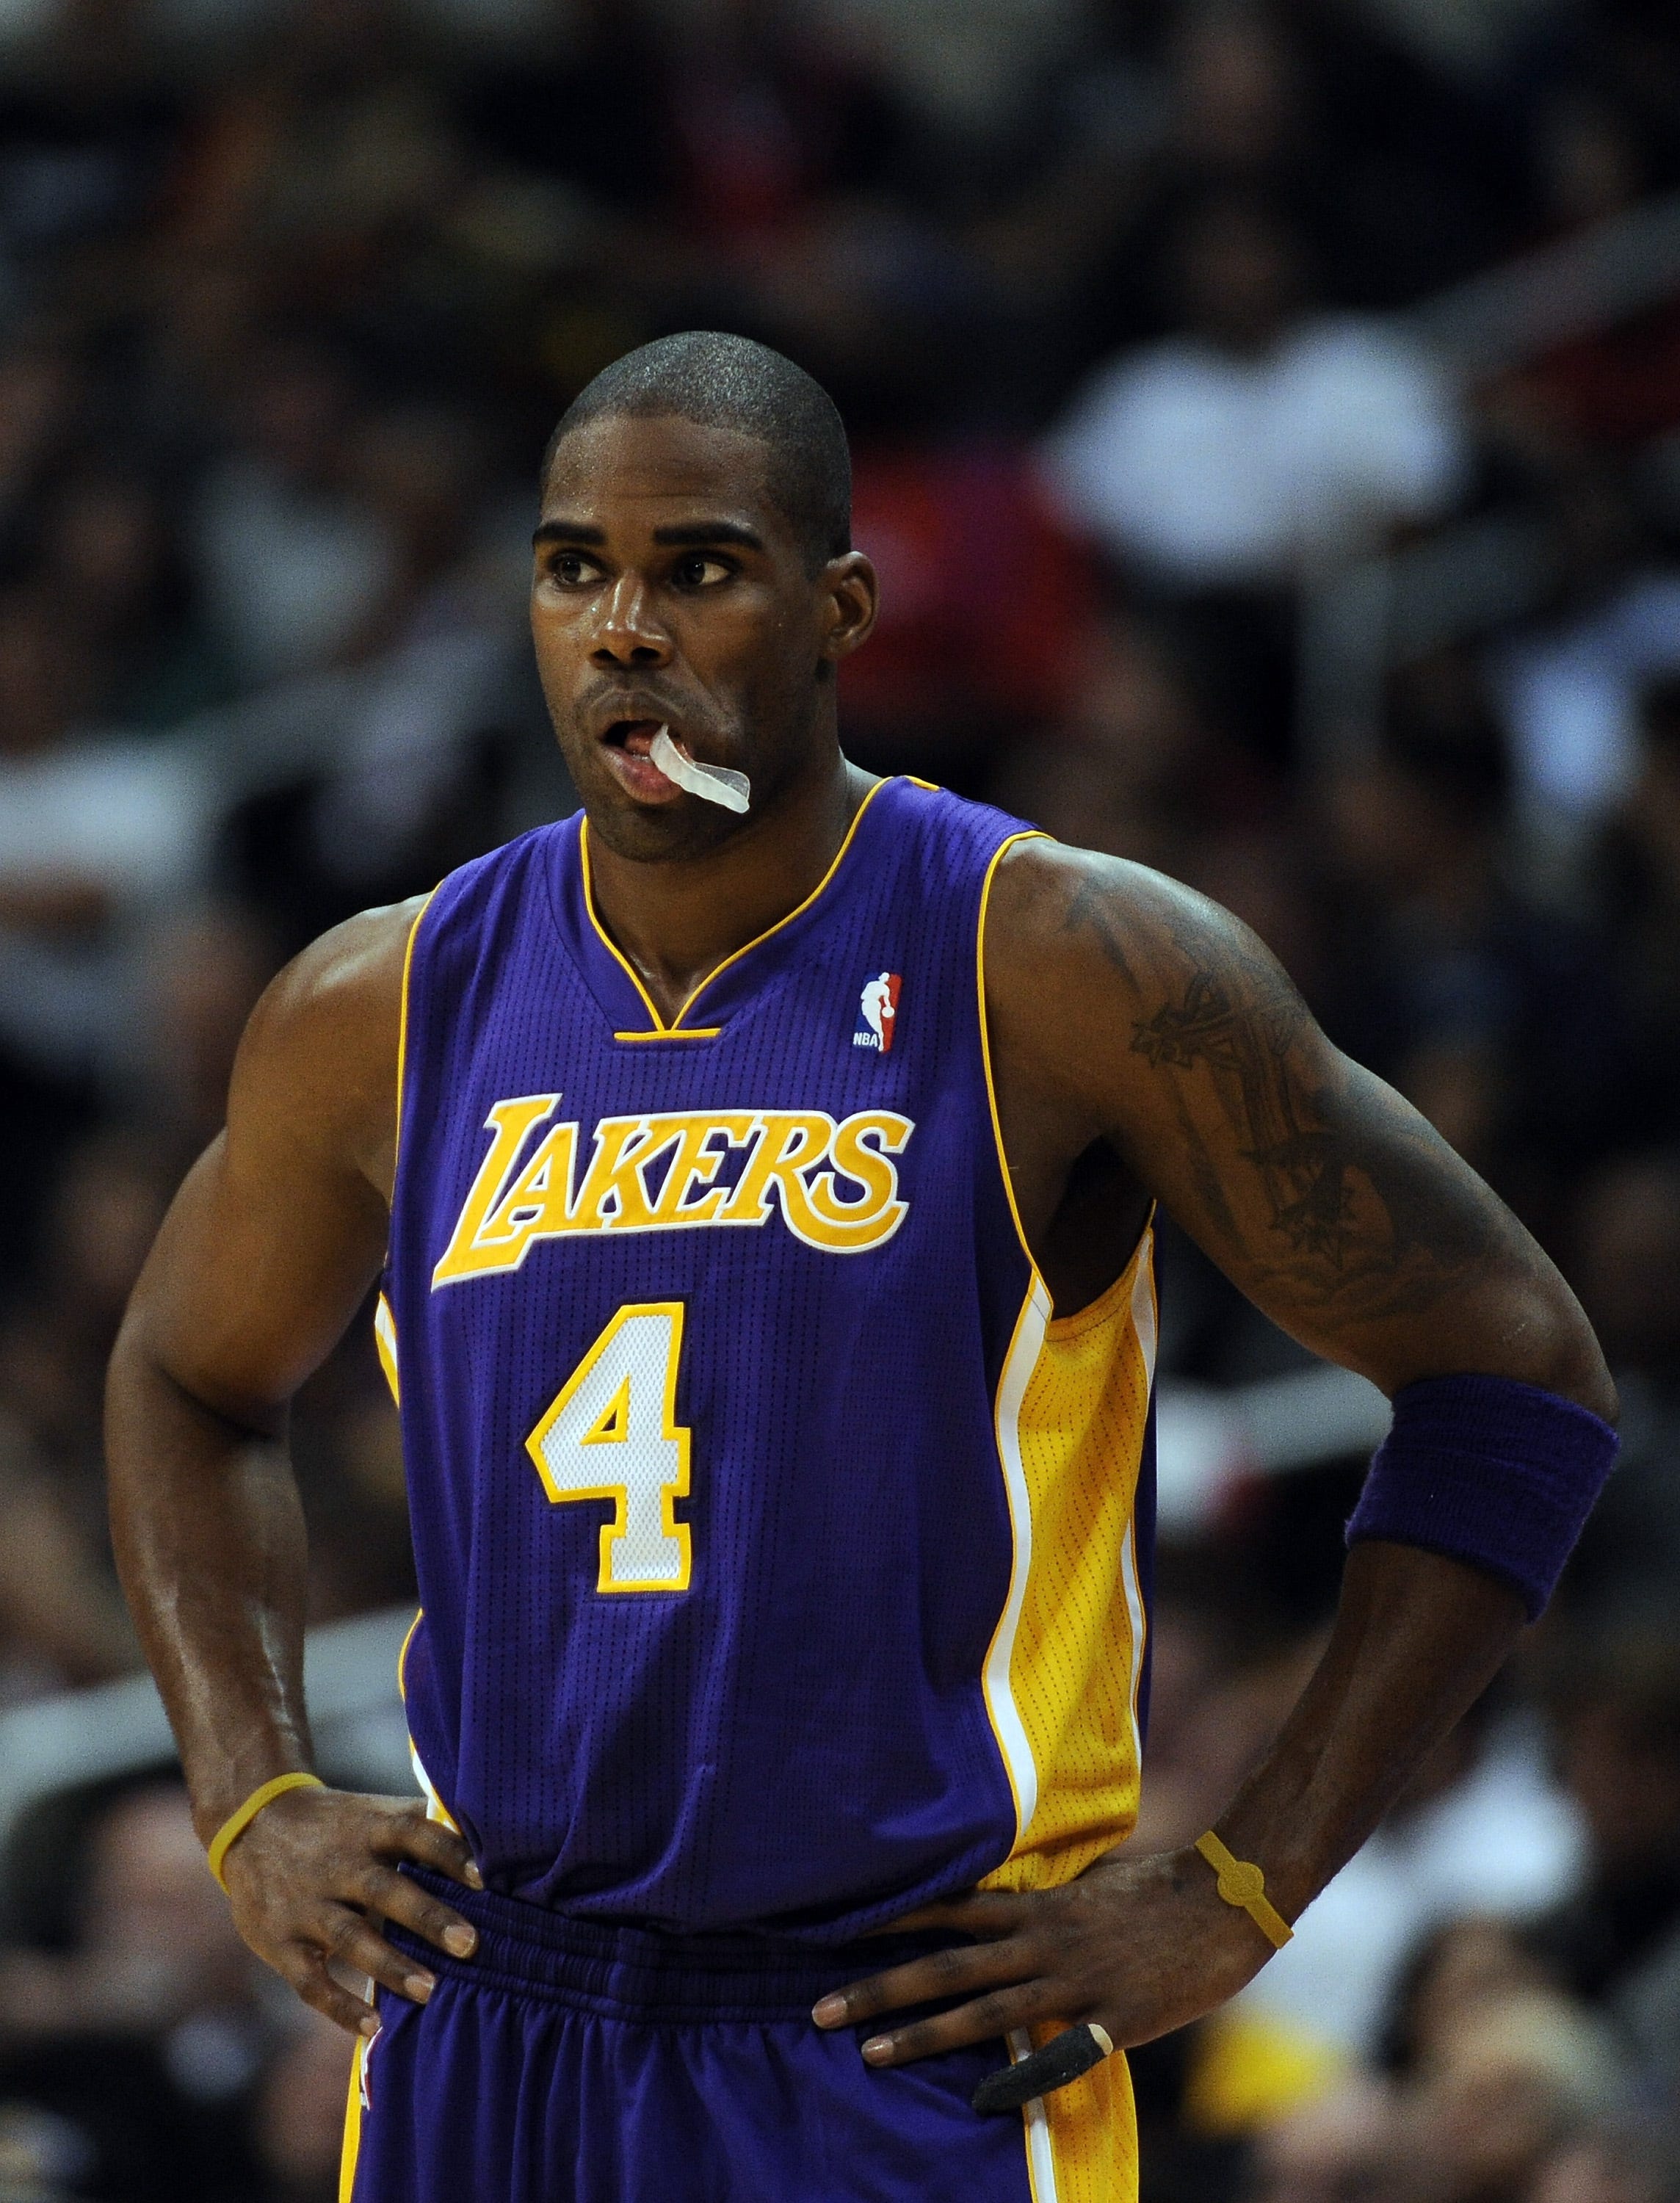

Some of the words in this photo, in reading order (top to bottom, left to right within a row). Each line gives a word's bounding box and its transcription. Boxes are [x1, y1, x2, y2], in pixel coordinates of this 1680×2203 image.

[852, 1032, 878, 1047] NBA
[431, 1093, 916, 1292] LAKERS
[525, 1302, 692, 1593] 4
